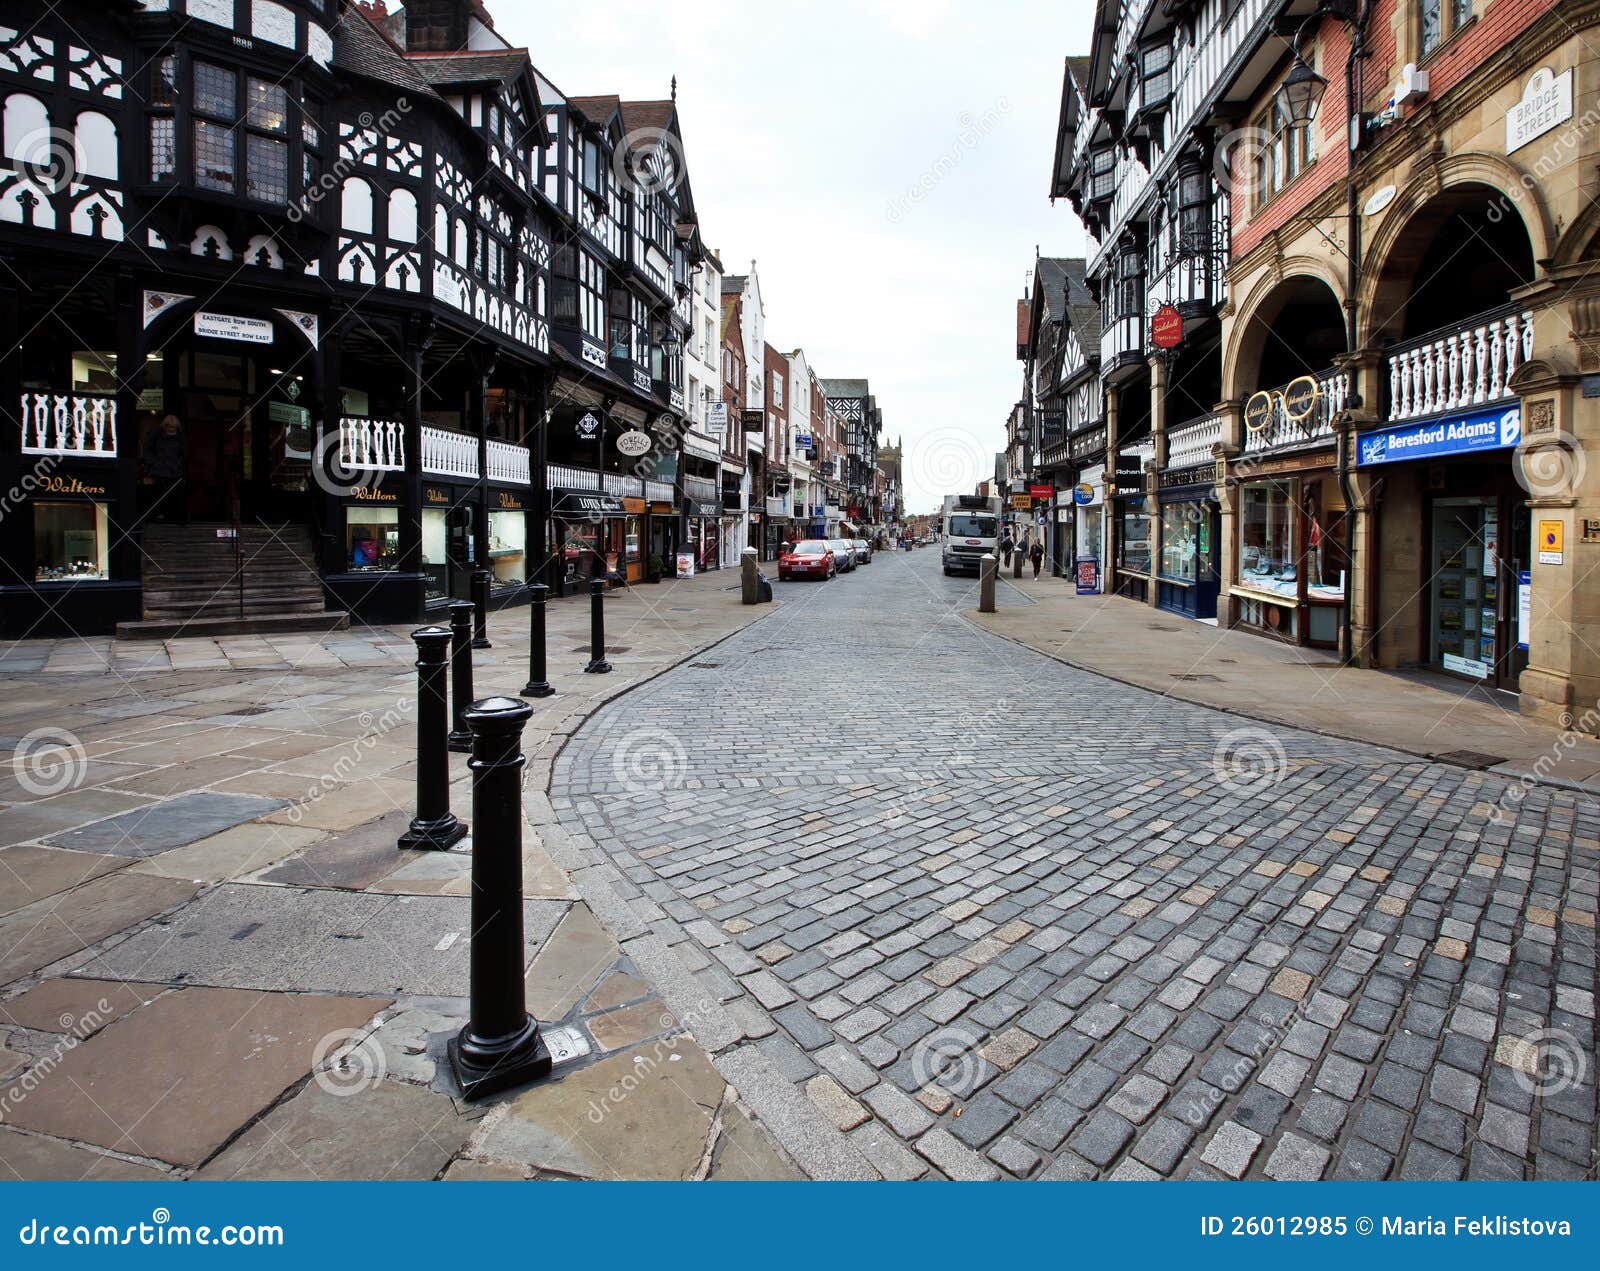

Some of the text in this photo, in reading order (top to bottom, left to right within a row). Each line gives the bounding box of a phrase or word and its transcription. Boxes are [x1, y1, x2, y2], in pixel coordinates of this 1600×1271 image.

[1517, 83, 1559, 123] BRIDGE
[1517, 102, 1559, 140] STREET
[202, 315, 231, 324] EASTGATE
[198, 327, 218, 335] BRIDGE
[1388, 420, 1496, 449] Beresford Adams
[38, 476, 105, 494] Waltons
[351, 486, 397, 501] Waltons
